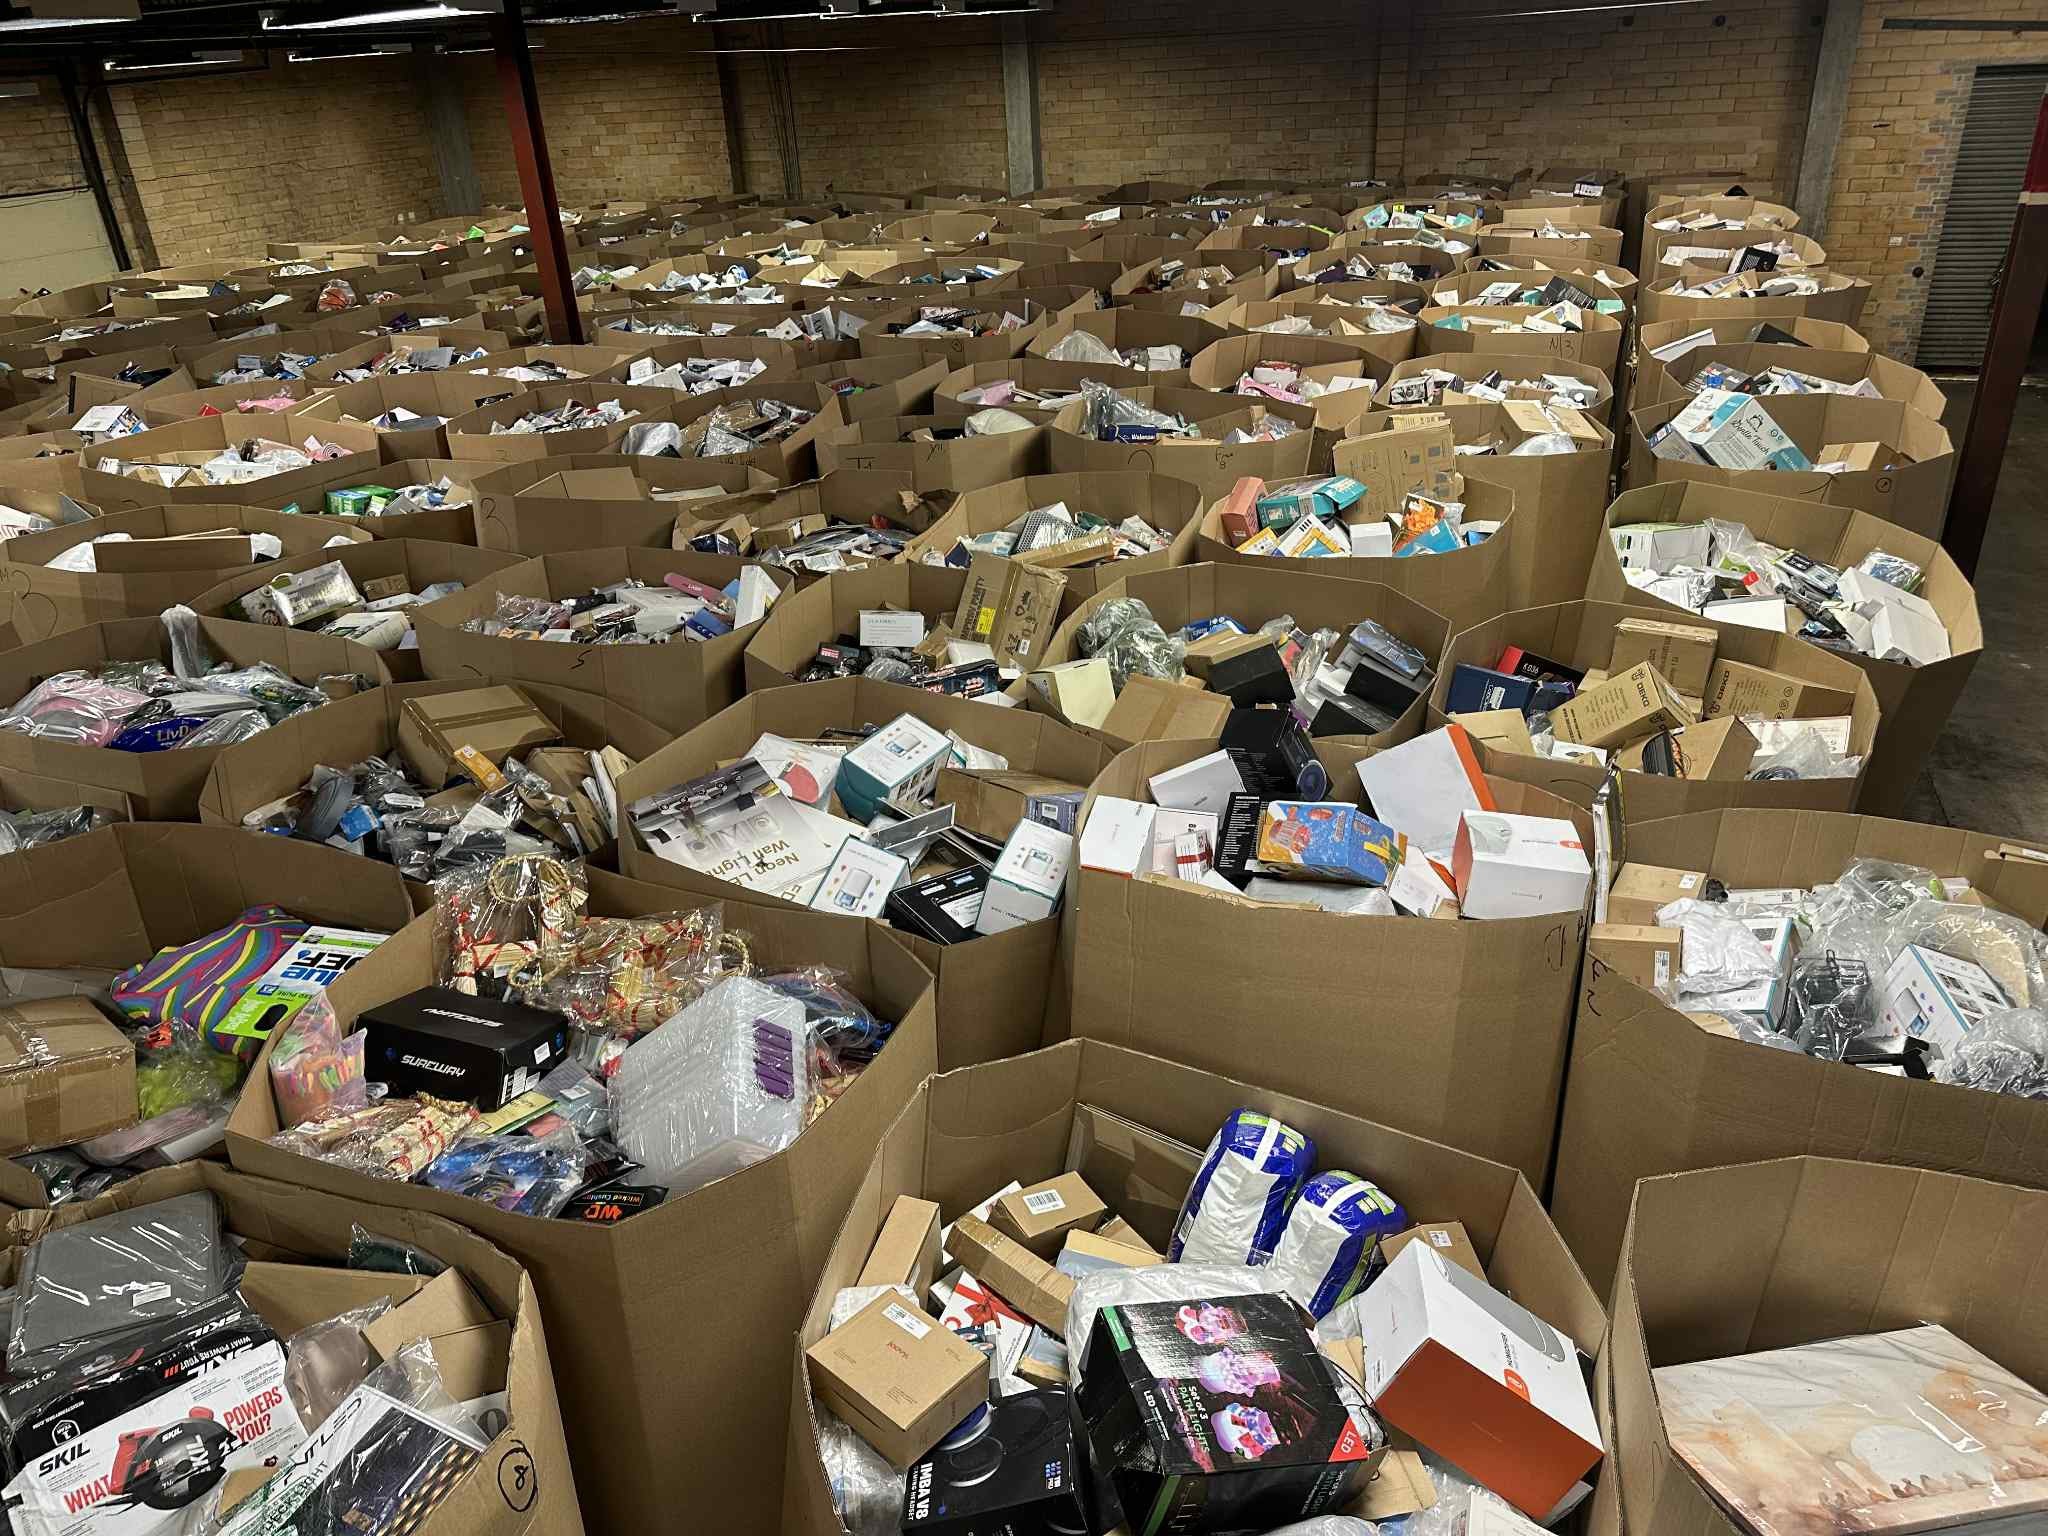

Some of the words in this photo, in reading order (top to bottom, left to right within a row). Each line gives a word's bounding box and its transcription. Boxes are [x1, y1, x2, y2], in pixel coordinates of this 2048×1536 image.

[400, 1053, 466, 1078] SUREWAY
[222, 1386, 284, 1431] POWERS
[1143, 1390, 1156, 1408] LED
[236, 1413, 273, 1447] YOU?
[1339, 1430, 1358, 1454] LED
[39, 1441, 91, 1478] SKIL
[513, 1464, 529, 1491] 8
[917, 1462, 935, 1498] IMBA
[63, 1474, 113, 1515] WHAT
[915, 1496, 930, 1521] V8
